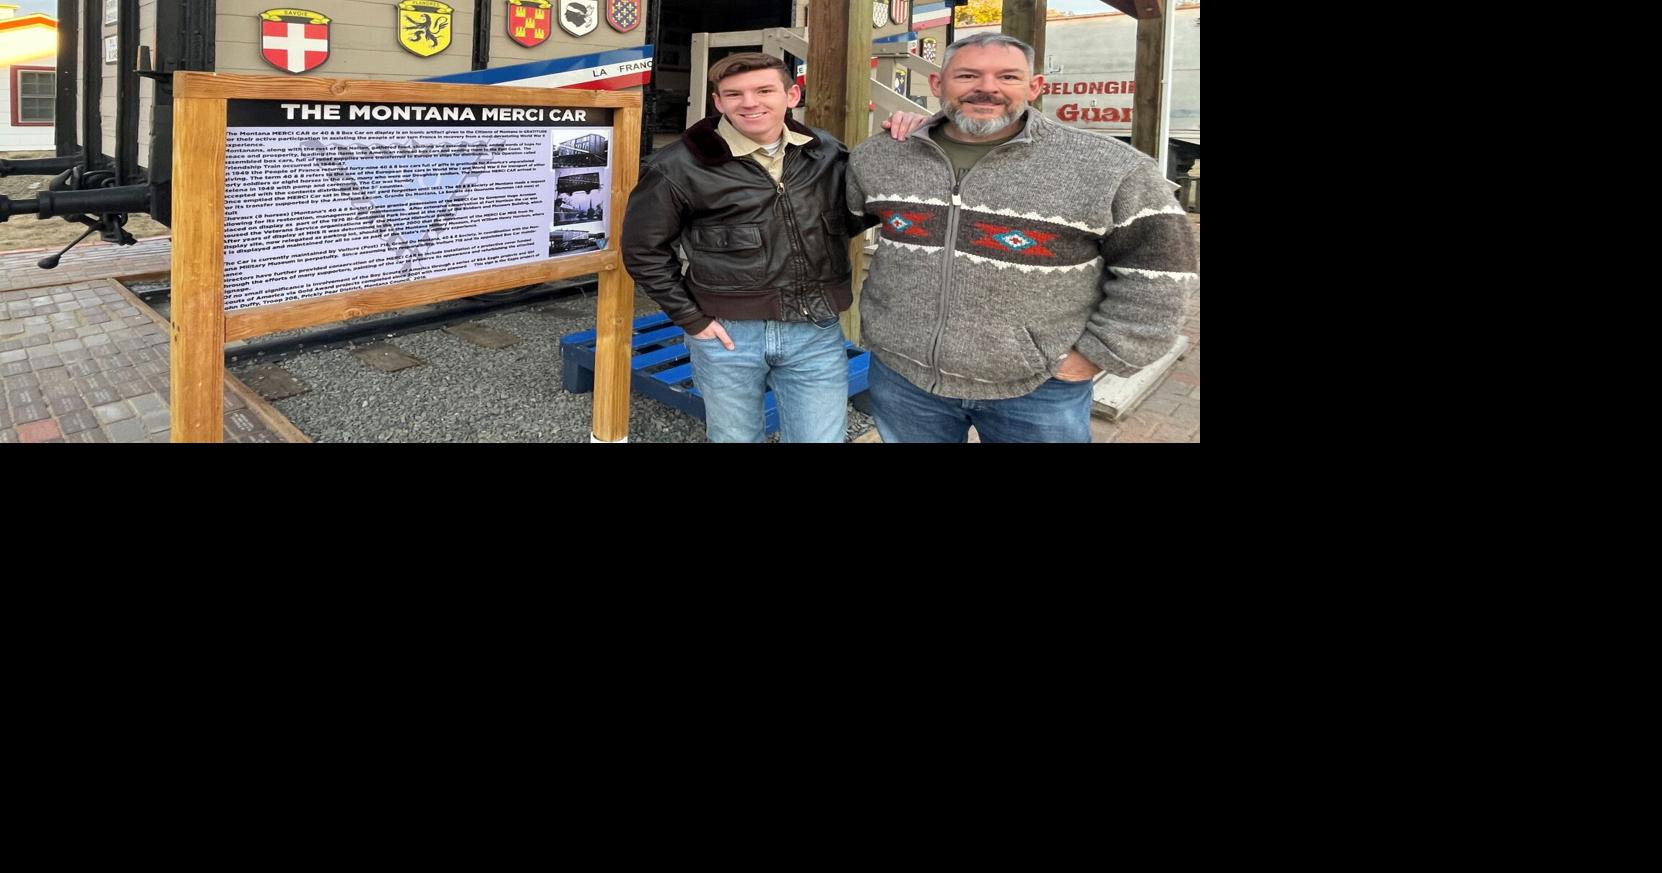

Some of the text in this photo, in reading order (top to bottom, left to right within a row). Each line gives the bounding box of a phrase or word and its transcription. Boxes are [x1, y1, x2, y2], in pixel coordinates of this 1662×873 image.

[592, 68, 607, 77] LA
[281, 104, 586, 122] THE MONTANA MERCI CAR
